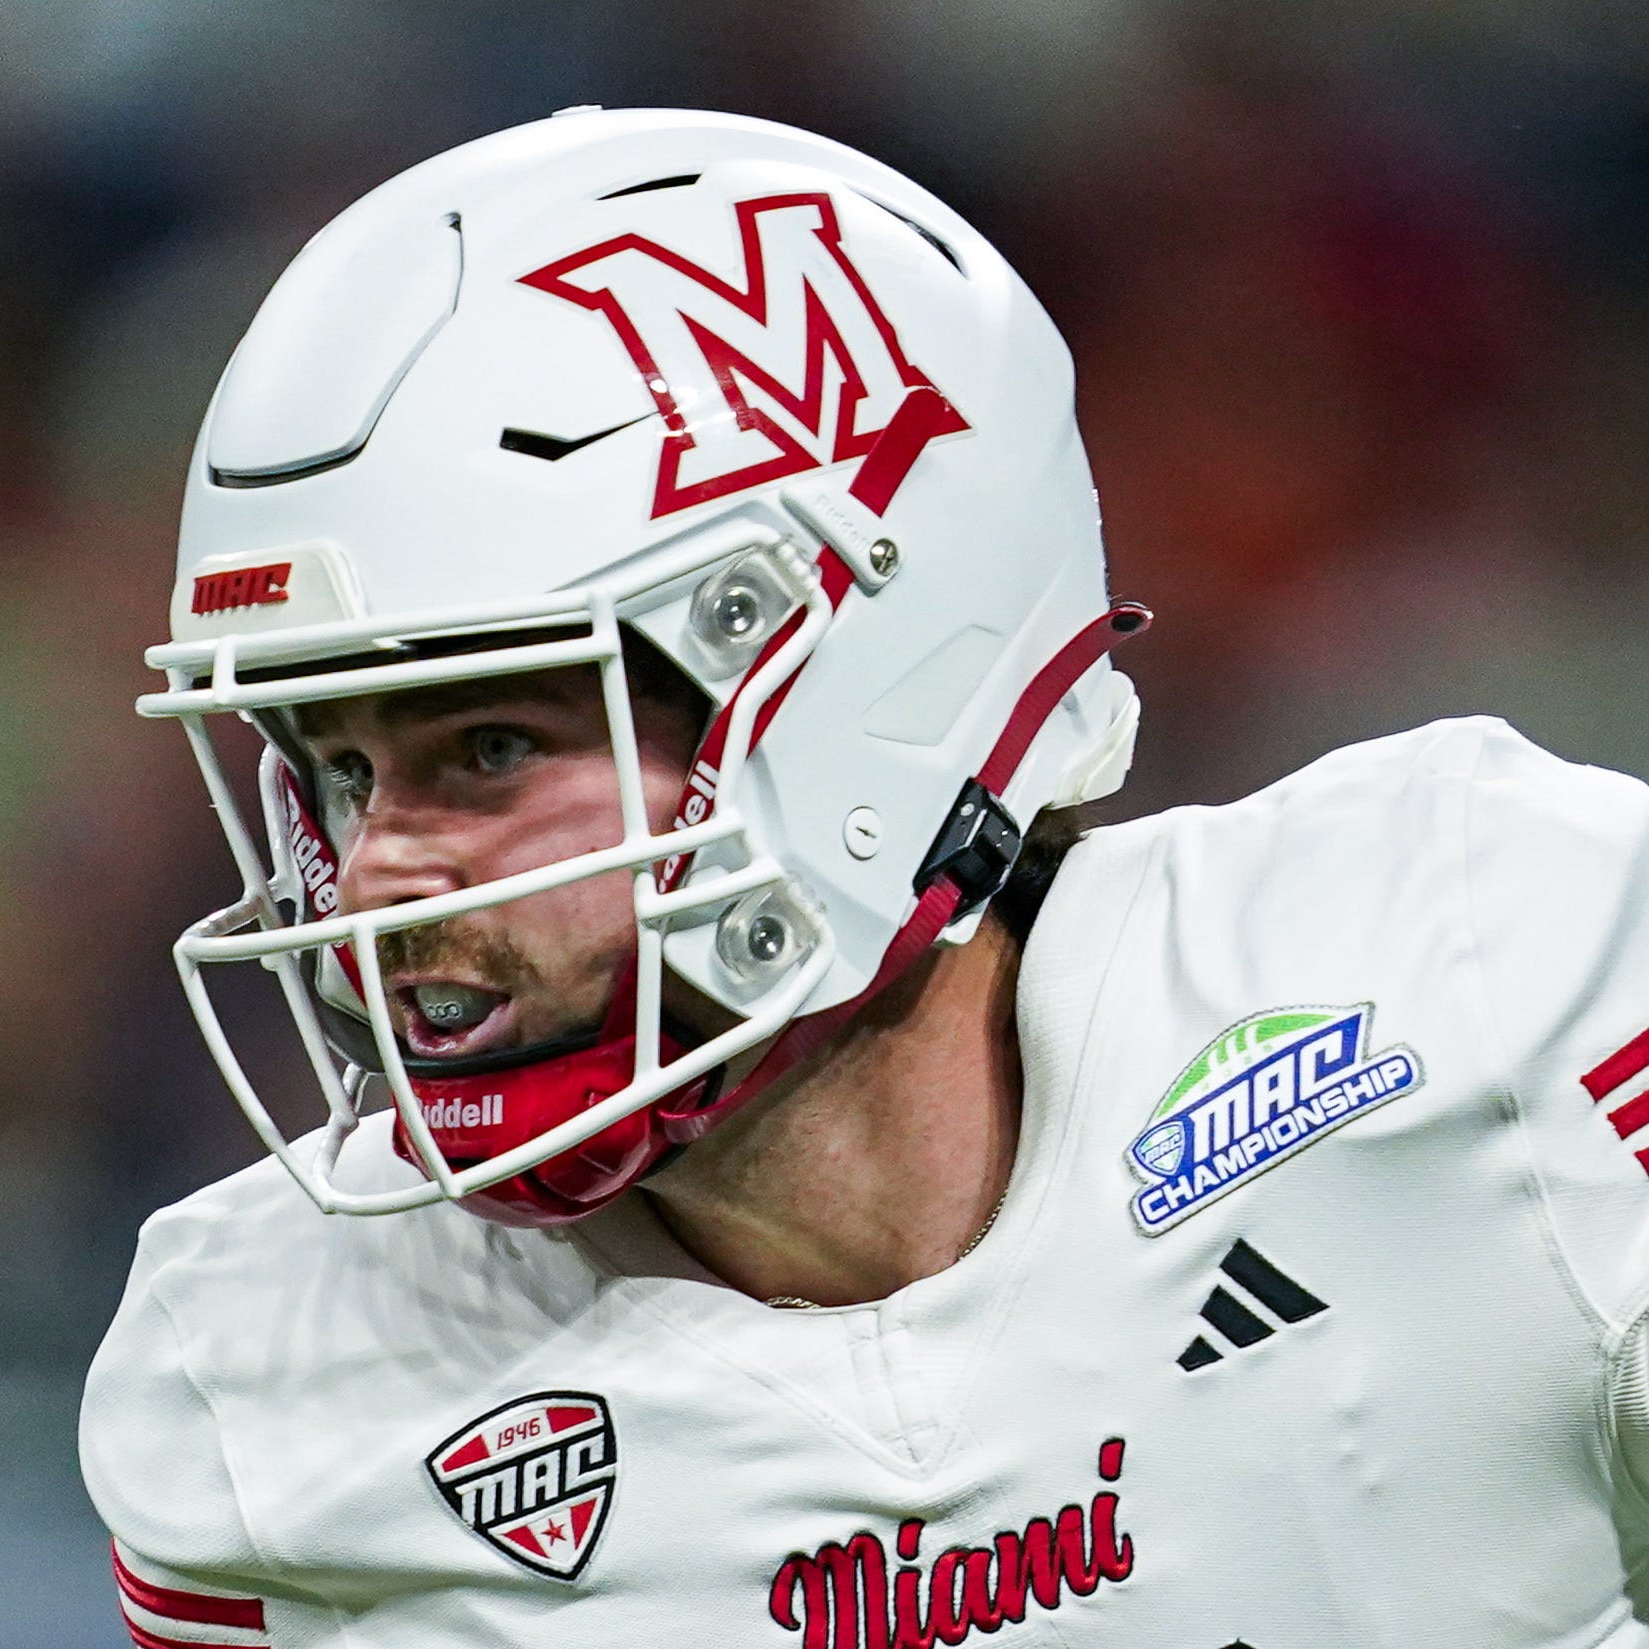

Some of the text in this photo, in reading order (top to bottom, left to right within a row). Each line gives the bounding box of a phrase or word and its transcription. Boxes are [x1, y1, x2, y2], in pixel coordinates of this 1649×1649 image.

[515, 192, 972, 520] M
[191, 562, 292, 616] MAC
[1138, 1056, 1409, 1222] CHAMPIONSHIP
[1188, 1029, 1350, 1163] MAC
[455, 1431, 617, 1529] MAC
[497, 1417, 542, 1450] 1946
